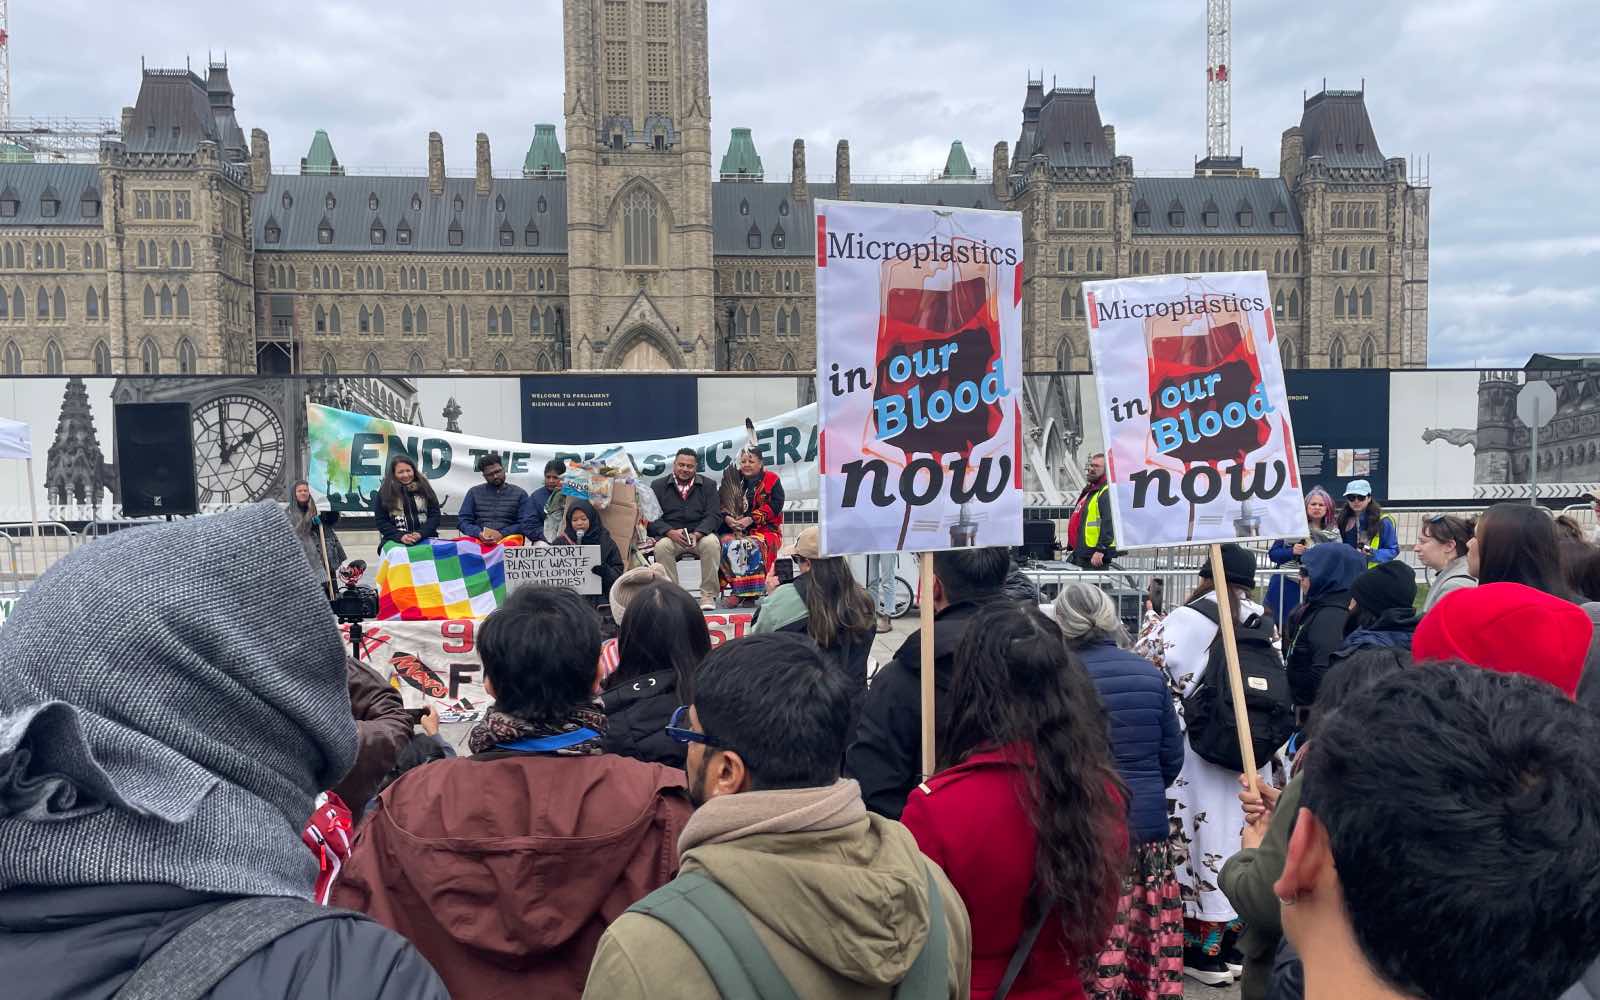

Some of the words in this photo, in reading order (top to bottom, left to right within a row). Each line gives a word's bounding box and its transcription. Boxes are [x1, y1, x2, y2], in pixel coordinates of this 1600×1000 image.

[827, 232, 1017, 269] Microplastics
[1098, 292, 1265, 322] Microplastics
[829, 363, 872, 397] in
[888, 341, 959, 384] our
[873, 357, 1011, 442] Blood
[1110, 397, 1148, 423] in
[1160, 371, 1222, 409] our
[1151, 381, 1276, 455] Blood
[351, 432, 453, 480] END
[841, 454, 1012, 508] now
[1129, 459, 1287, 509] now
[507, 559, 544, 571] PLASTIC
[550, 557, 591, 569] WASTE
[507, 571, 520, 580] TO
[521, 567, 584, 579] DEVELOPING
[535, 546, 584, 558] EXPORT
[704, 614, 752, 650] ST
